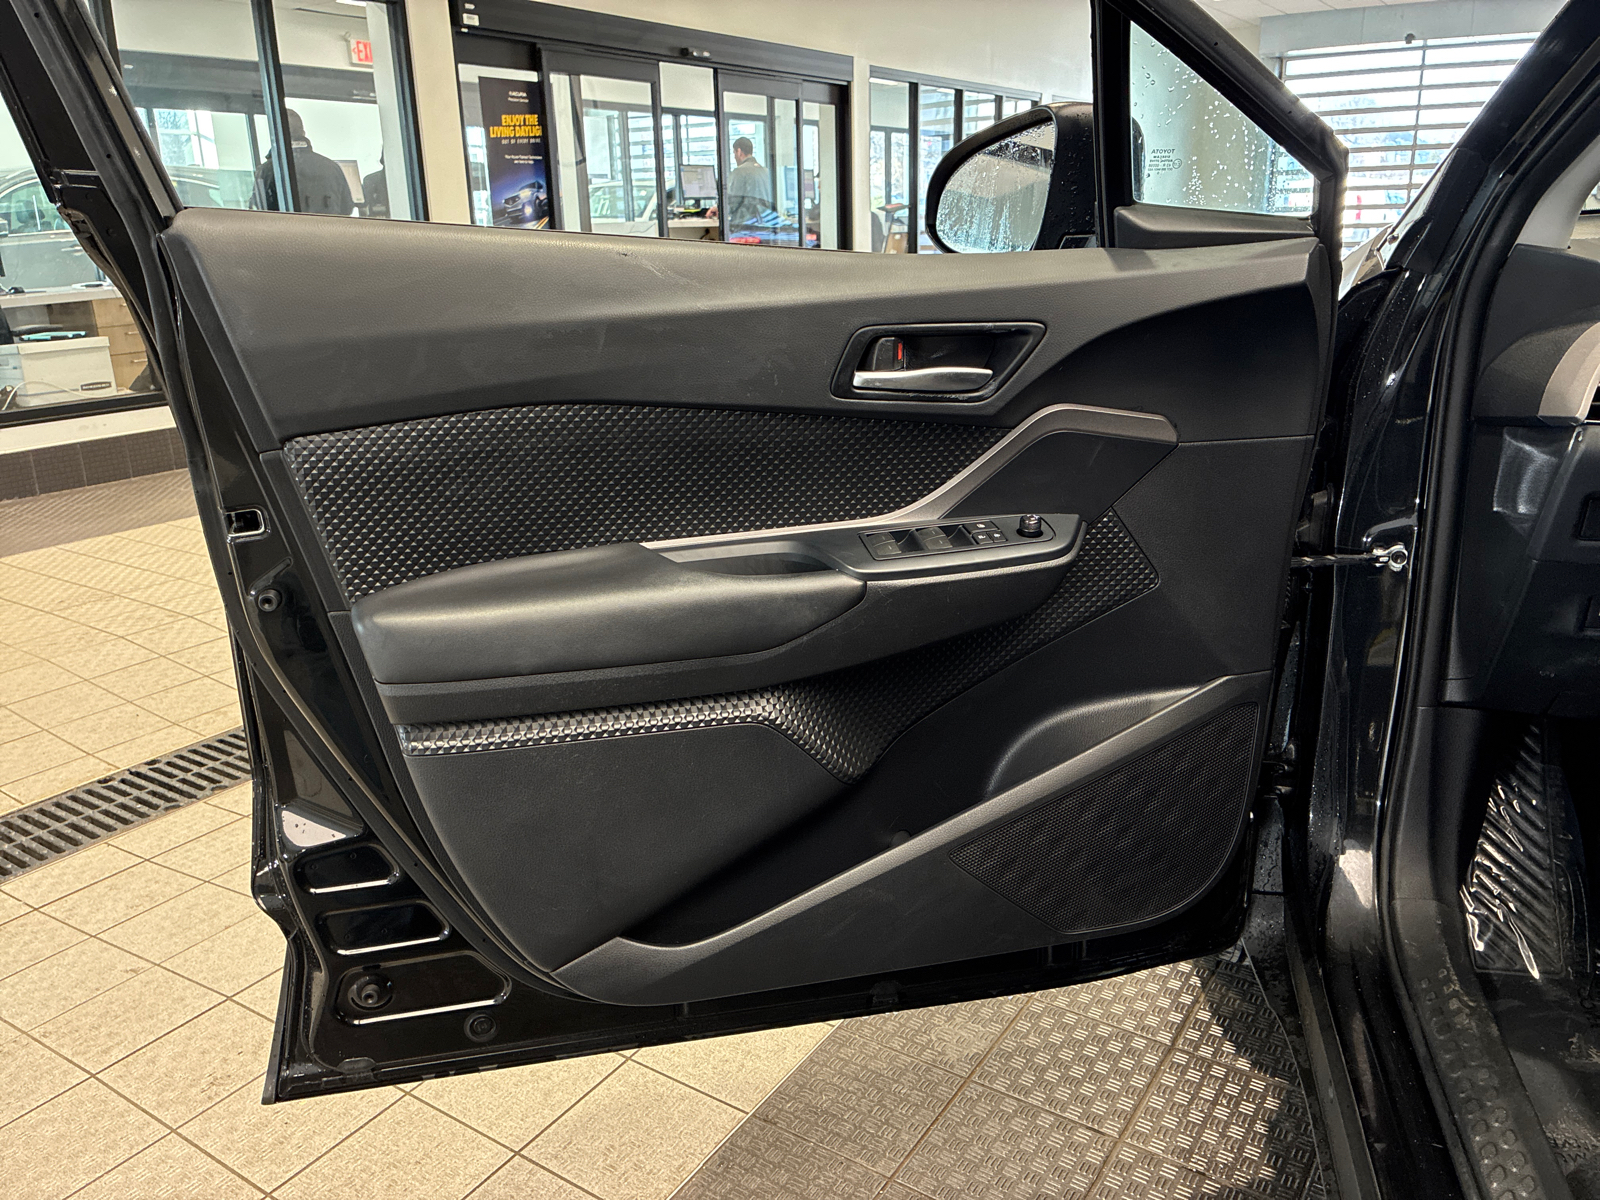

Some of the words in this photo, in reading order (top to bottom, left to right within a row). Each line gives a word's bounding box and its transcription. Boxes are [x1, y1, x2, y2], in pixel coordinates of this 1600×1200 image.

[356, 40, 373, 63] EXI
[502, 114, 524, 126] ENJOY
[525, 114, 538, 125] THE
[490, 126, 514, 138] LIVING
